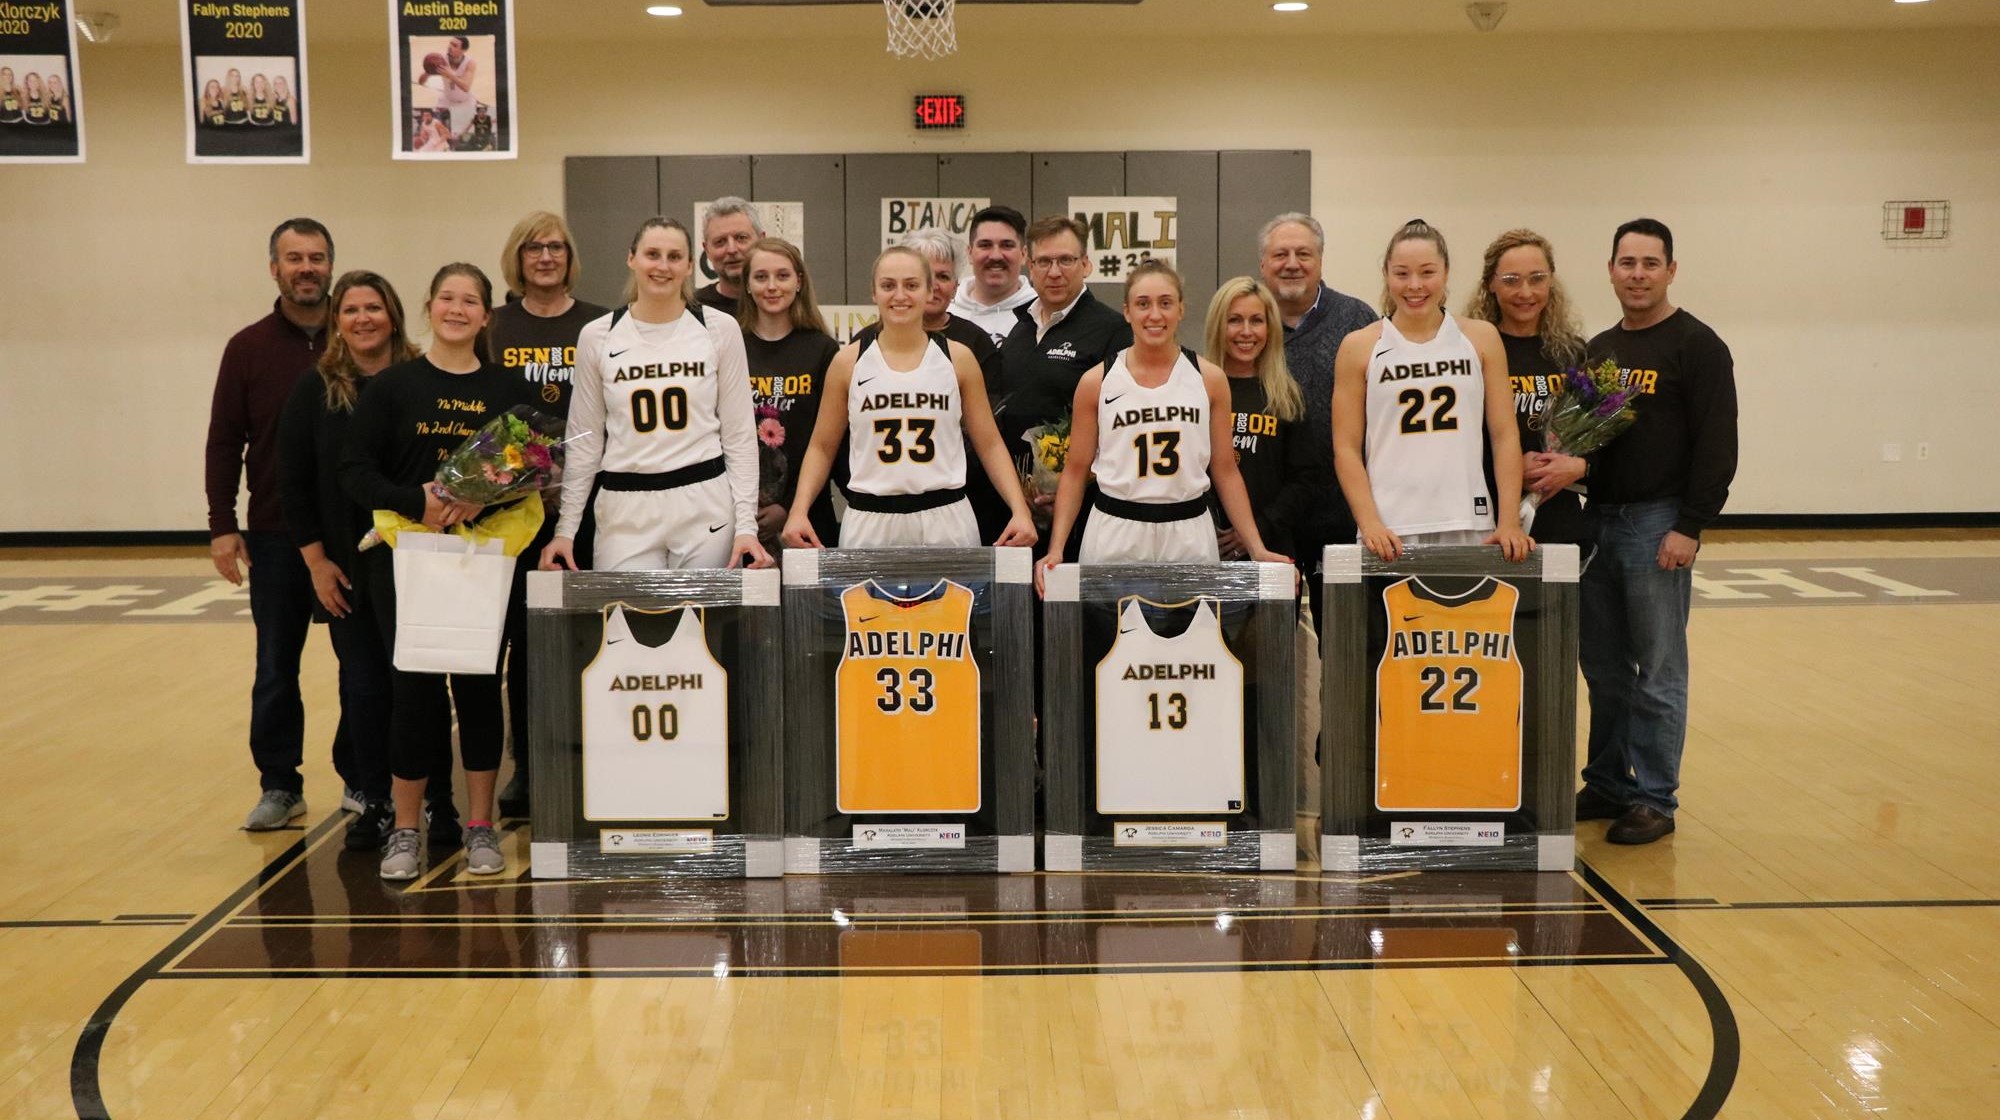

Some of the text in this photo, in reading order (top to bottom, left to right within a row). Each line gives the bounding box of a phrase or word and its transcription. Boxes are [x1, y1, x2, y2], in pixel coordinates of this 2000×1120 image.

[193, 3, 290, 18] Fallyn Stephens
[403, 1, 498, 16] Austin Beech
[226, 22, 263, 38] 2020
[439, 17, 467, 30] 2020
[923, 97, 957, 125] EXIT
[889, 200, 977, 234] BIANCA
[1074, 211, 1177, 250] MALI
[1046, 348, 1077, 359] ADELPHI
[524, 360, 576, 386] Mom
[613, 361, 705, 384] ADELPHI
[1378, 358, 1472, 384] ADELPHI
[631, 386, 688, 434] 00
[860, 392, 949, 412] ADELPHI
[1397, 385, 1460, 436] 22
[1111, 406, 1200, 430] ADELPHI
[873, 417, 936, 465] 33
[1133, 429, 1183, 479] 13
[1232, 435, 1258, 454] om
[848, 630, 966, 662] ADELPHI
[1392, 630, 1512, 662] ADELPHI
[608, 673, 704, 692] ADELPHI
[1122, 664, 1216, 680] ADELPHI
[876, 666, 937, 715] 33
[1419, 666, 1481, 714] 22
[631, 703, 679, 742] 00
[1148, 691, 1189, 731] 13
